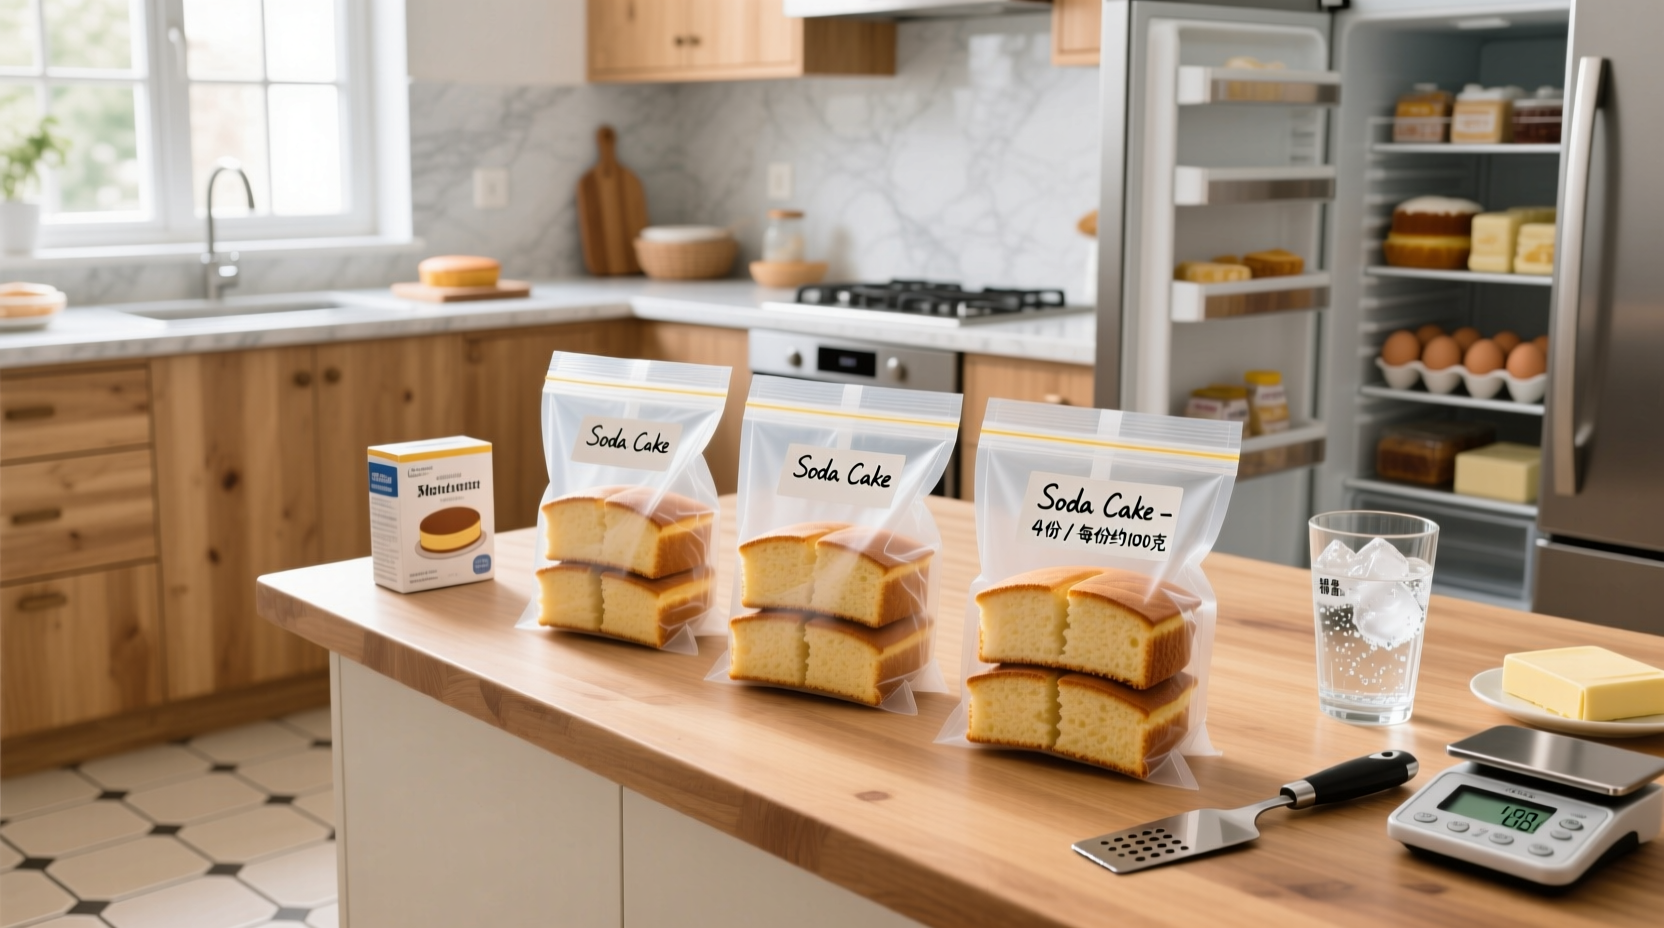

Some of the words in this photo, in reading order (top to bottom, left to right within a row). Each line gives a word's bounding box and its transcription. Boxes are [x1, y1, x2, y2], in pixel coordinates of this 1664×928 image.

[586, 424, 627, 450] Soda
[633, 431, 669, 454] Cake
[793, 454, 840, 482] Soda
[847, 462, 892, 488] Cake
[1037, 483, 1094, 514] Soda
[1103, 492, 1154, 521] Cake
[1032, 519, 1062, 540] 4份
